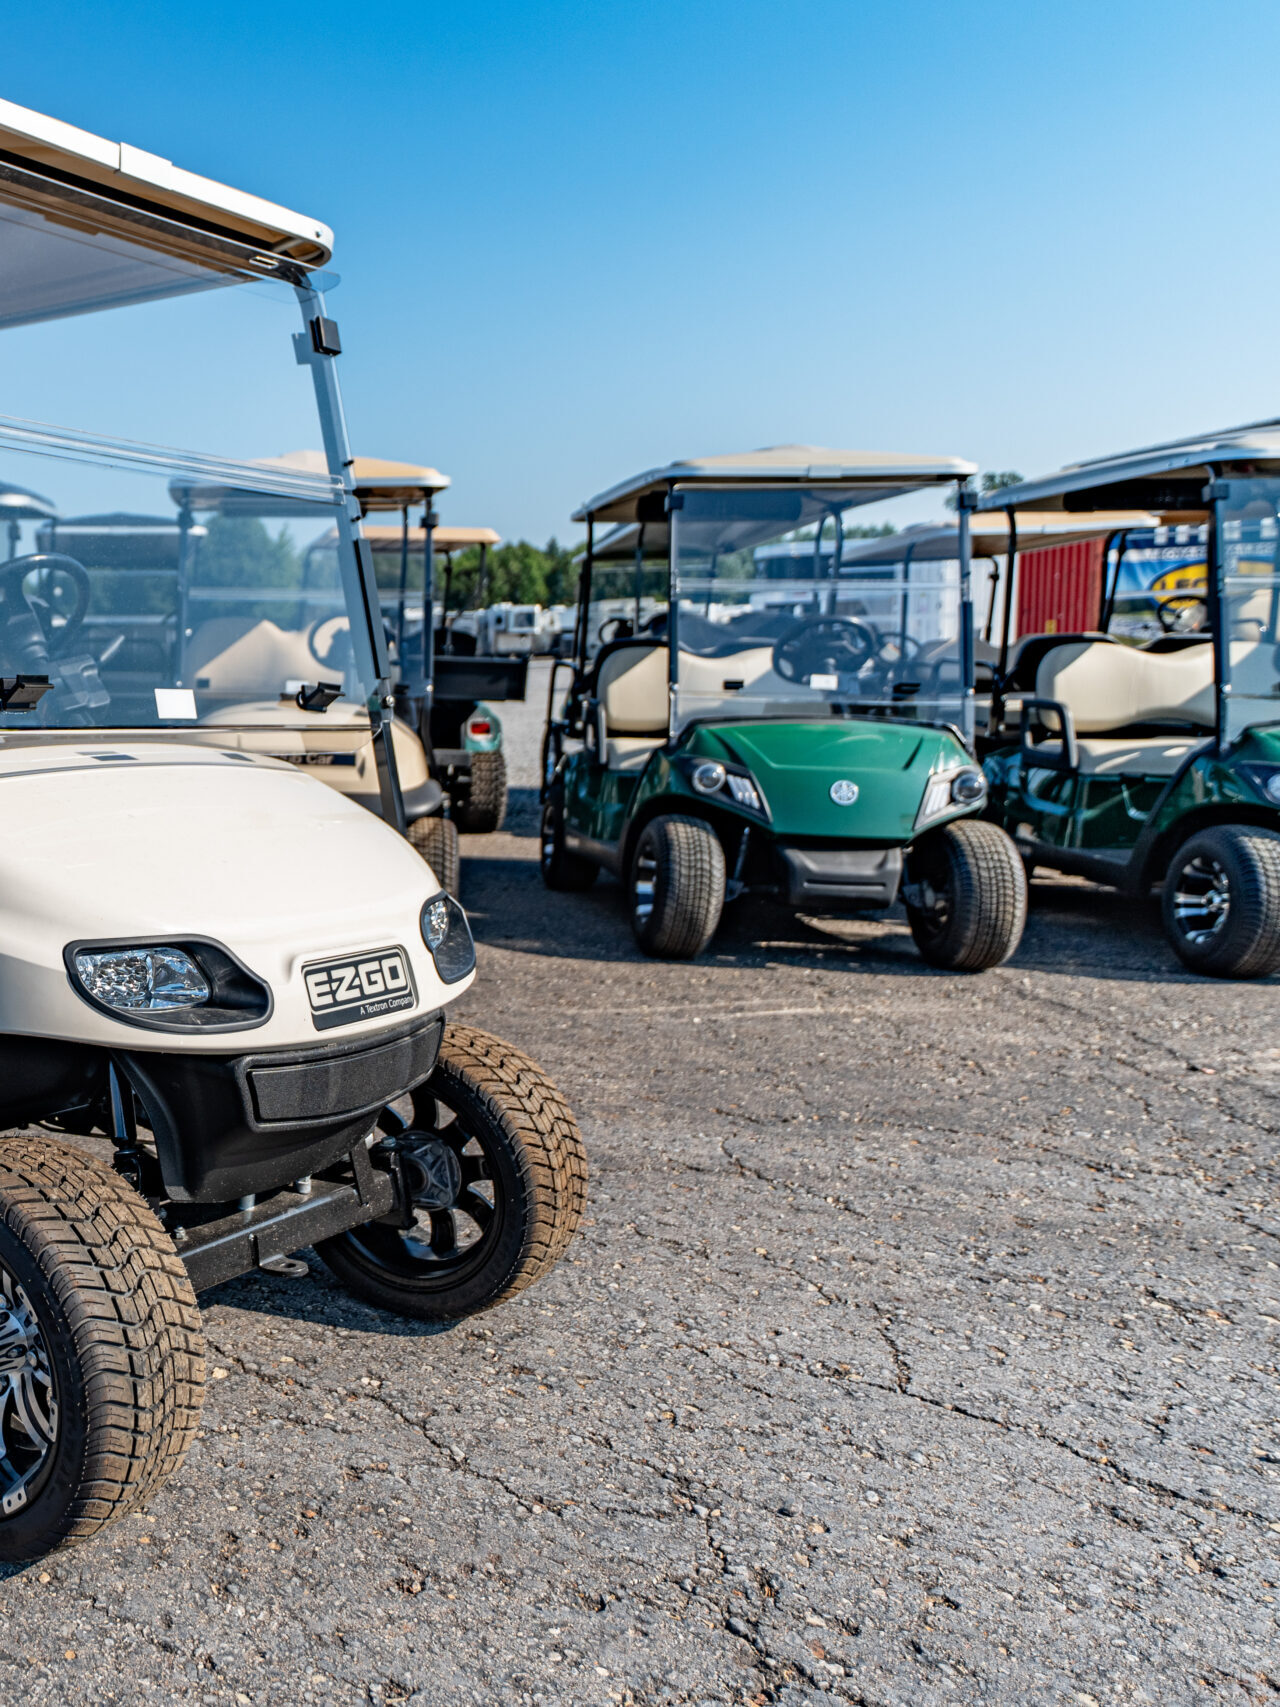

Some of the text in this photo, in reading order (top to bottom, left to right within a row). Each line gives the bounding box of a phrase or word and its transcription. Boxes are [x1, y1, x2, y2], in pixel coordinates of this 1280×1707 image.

[306, 753, 335, 765] Car
[360, 996, 414, 1015] A Textron Company
